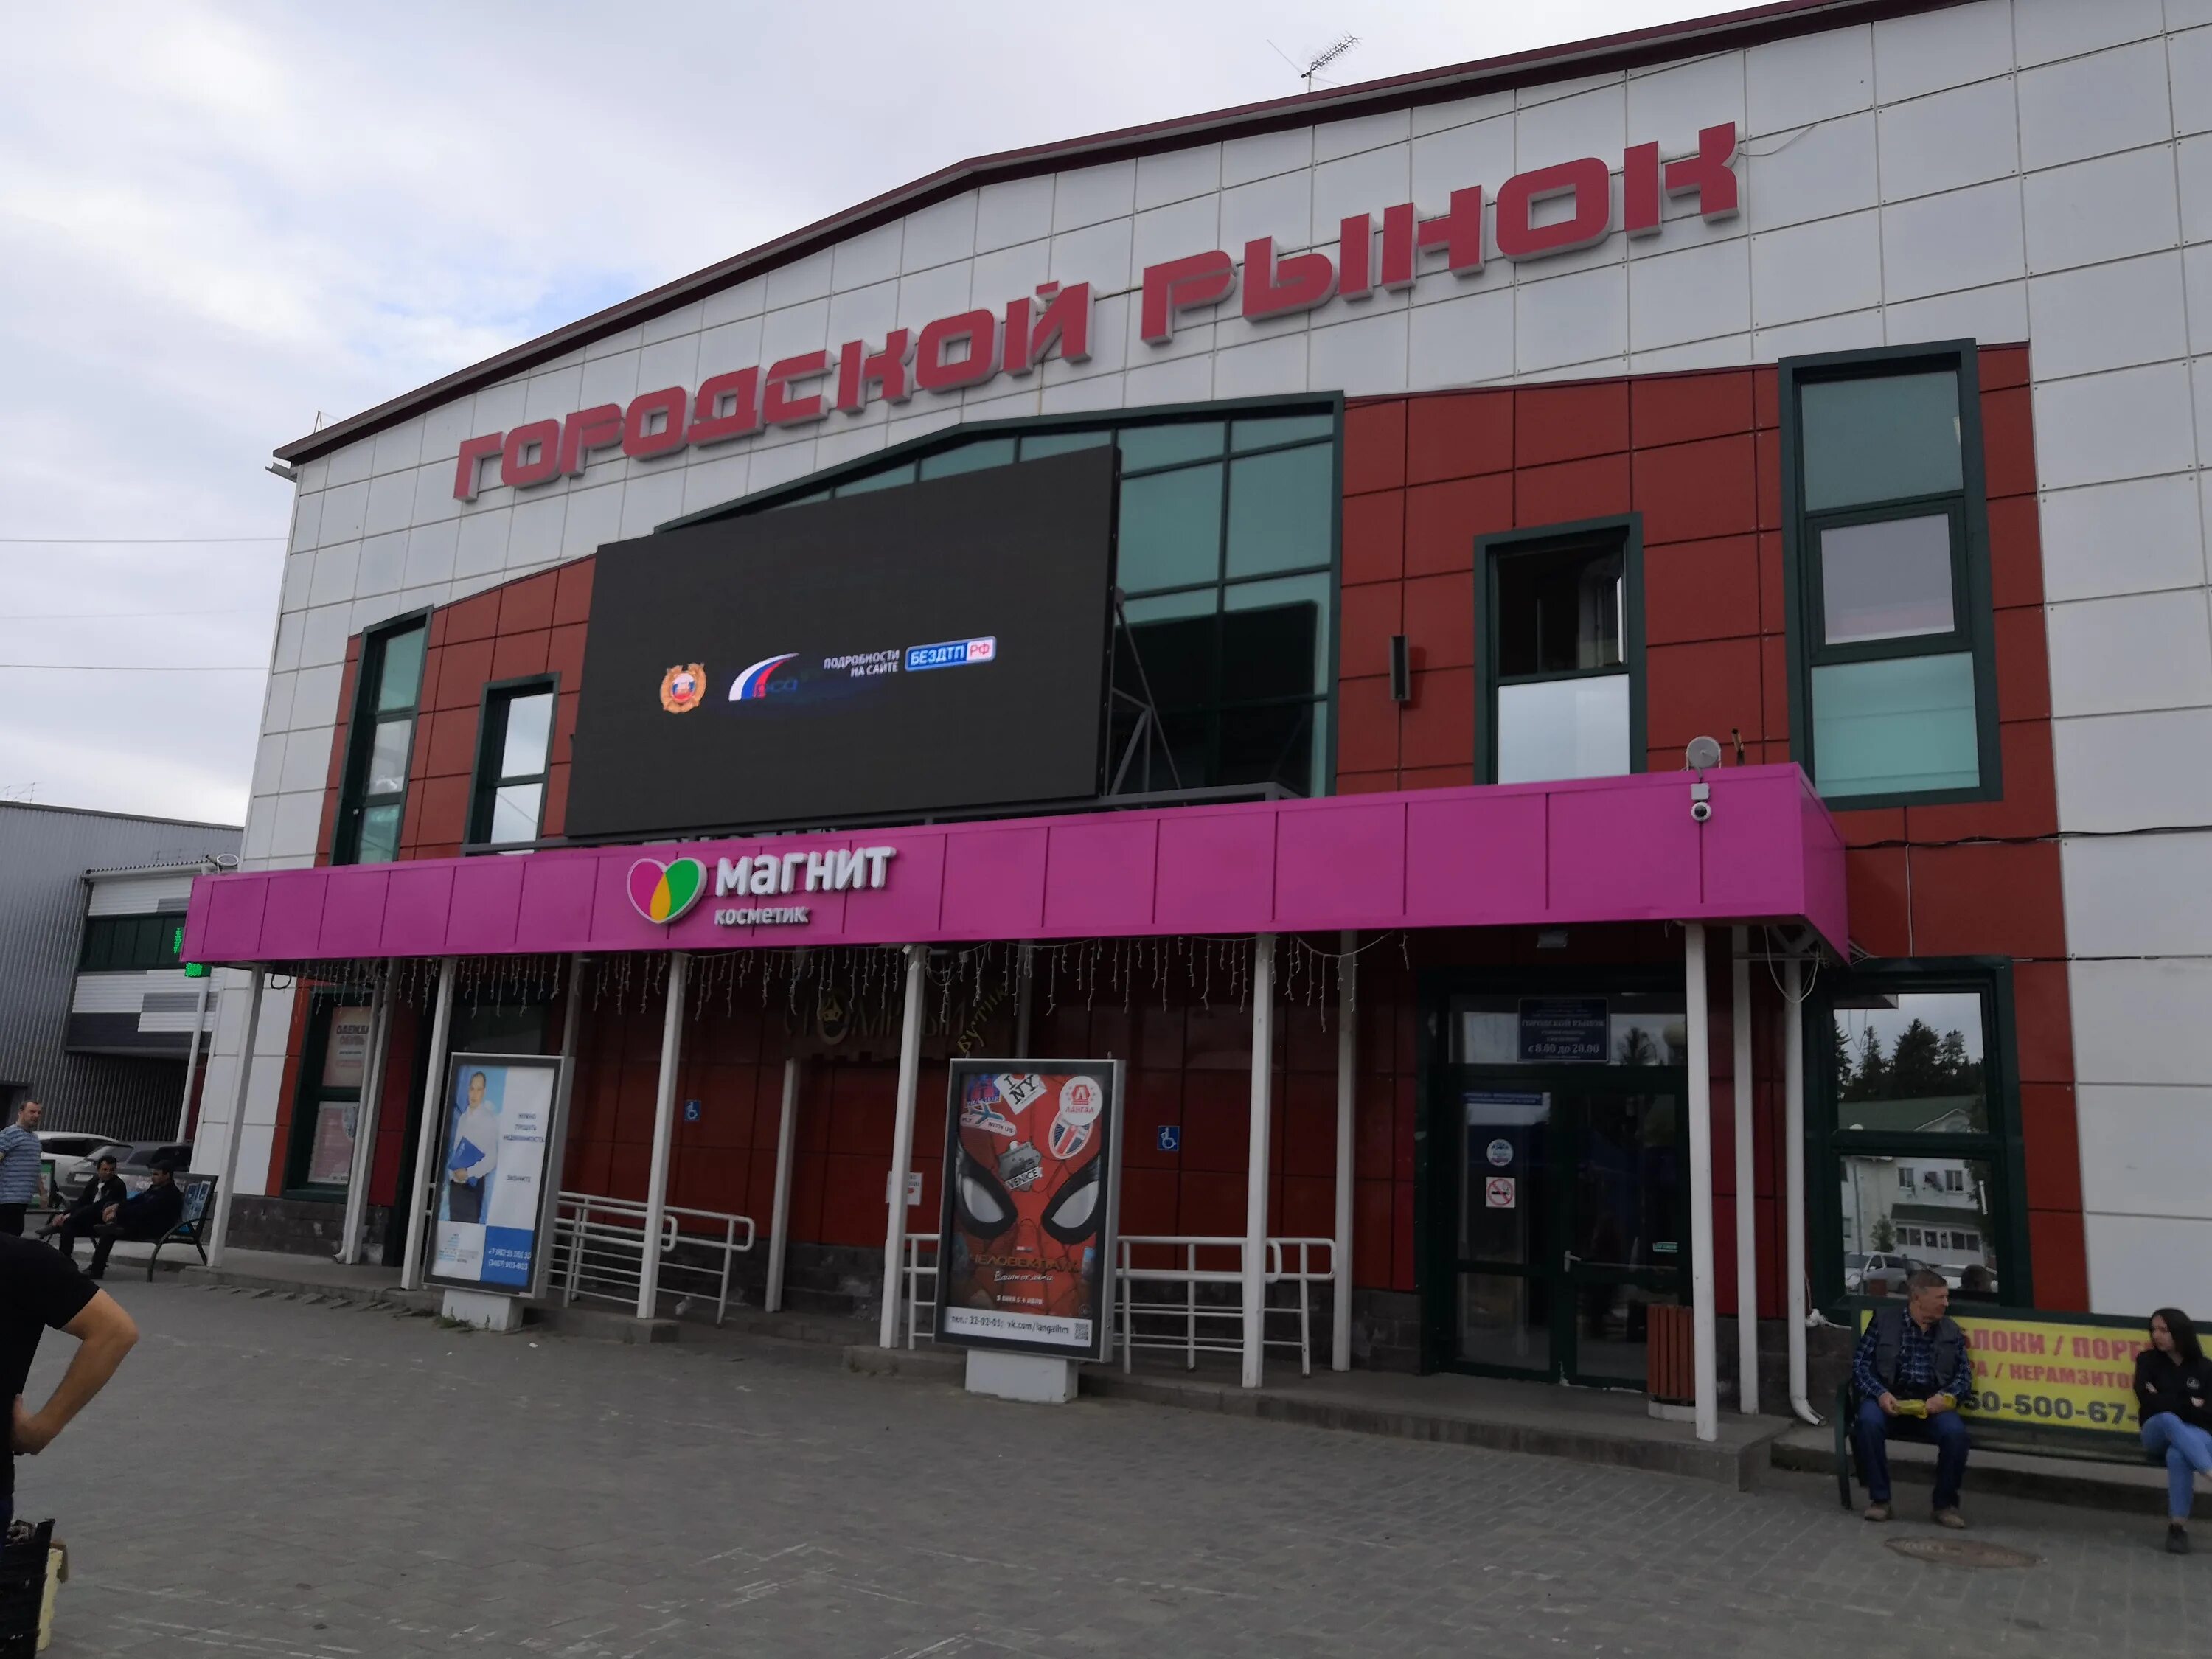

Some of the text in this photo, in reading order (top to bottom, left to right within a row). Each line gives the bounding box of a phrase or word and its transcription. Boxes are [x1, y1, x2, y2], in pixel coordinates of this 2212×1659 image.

[453, 121, 1740, 503] ГОРОДСКОЙ РЫНОК
[823, 649, 900, 670] ПОДРОБНОСТИ
[850, 662, 899, 678] НА САЙТЕ
[1009, 1074, 1039, 1105] NY
[1008, 1168, 1039, 1188] VENICE
